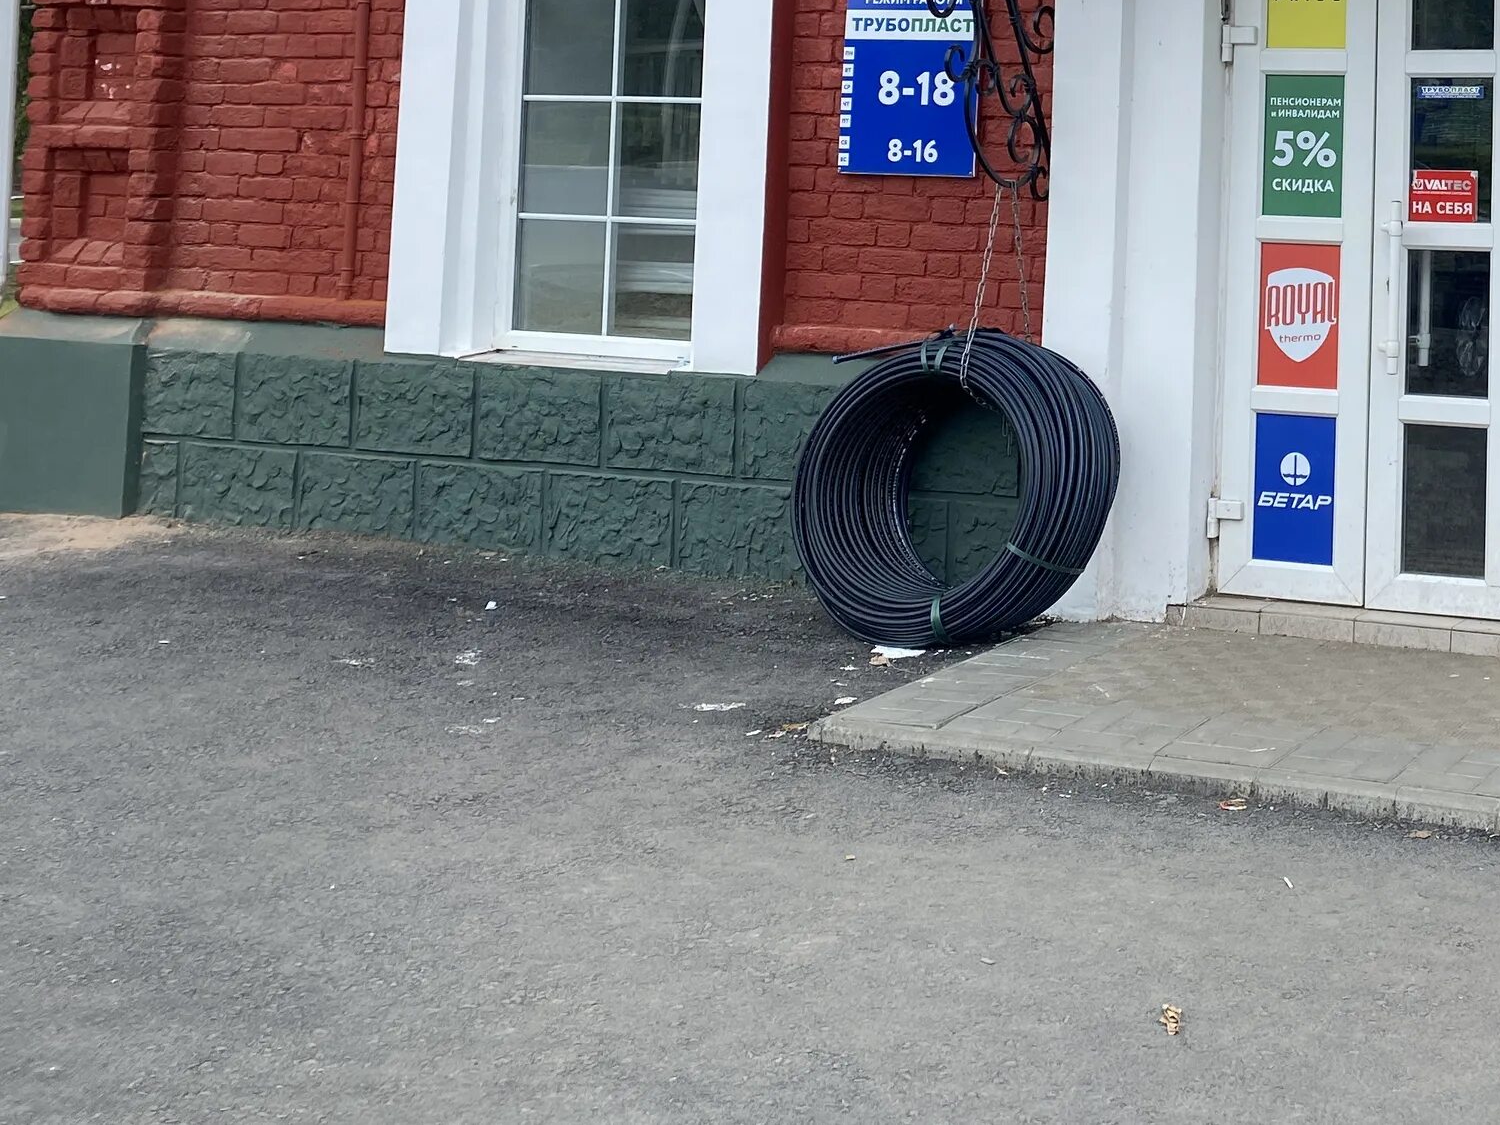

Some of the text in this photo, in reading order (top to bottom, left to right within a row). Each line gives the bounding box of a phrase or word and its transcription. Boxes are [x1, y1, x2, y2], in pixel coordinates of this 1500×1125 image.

[852, 17, 976, 33] ТРУБОПЛАСТ
[878, 70, 955, 107] 8-18
[1270, 97, 1342, 107] ПЕНСИОНЕРАМ
[1278, 109, 1340, 119] ИНВАЛИДАМ
[887, 138, 939, 163] 8-16
[1272, 130, 1337, 168] 5%
[1272, 178, 1335, 193] СКИДКА
[1424, 179, 1472, 191] VALTEC
[1412, 201, 1473, 215] НА СЕБЯ
[1266, 281, 1337, 328] ROYAL
[1279, 334, 1321, 343] thermo
[1257, 490, 1333, 511] БЕТАР
